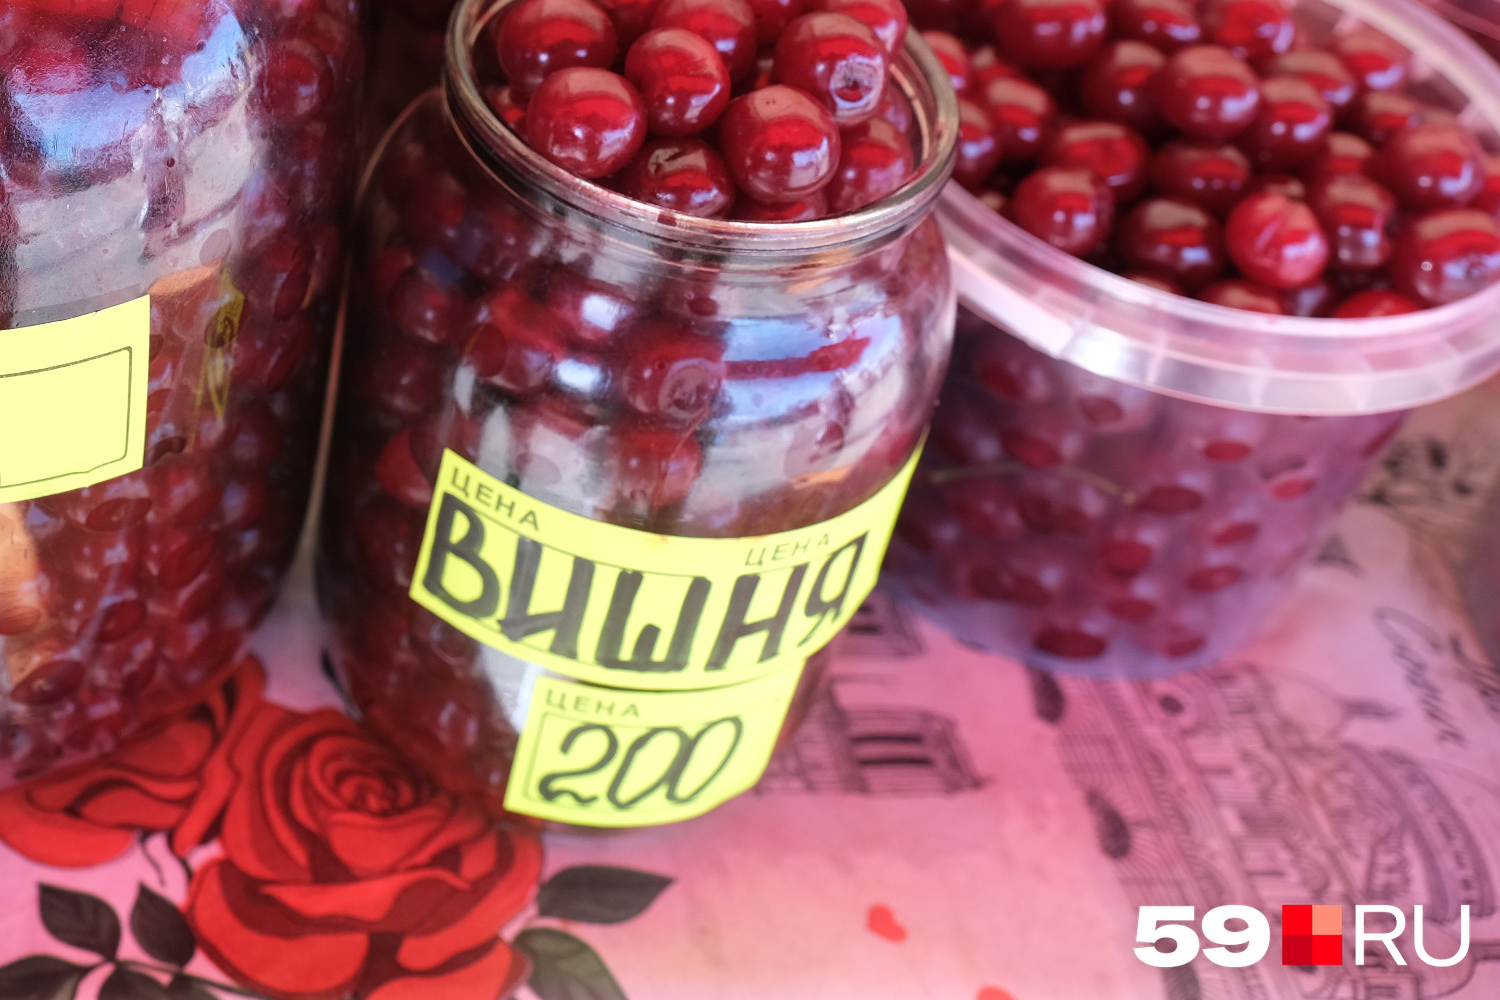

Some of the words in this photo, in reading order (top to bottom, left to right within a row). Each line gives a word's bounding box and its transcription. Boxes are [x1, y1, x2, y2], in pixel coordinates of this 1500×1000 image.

[450, 466, 540, 532] ЦЕНА
[421, 490, 870, 673] ВИШНЯ
[744, 532, 831, 567] ЦЕНА
[545, 688, 641, 718] ЦЕНА
[538, 714, 745, 810] 200
